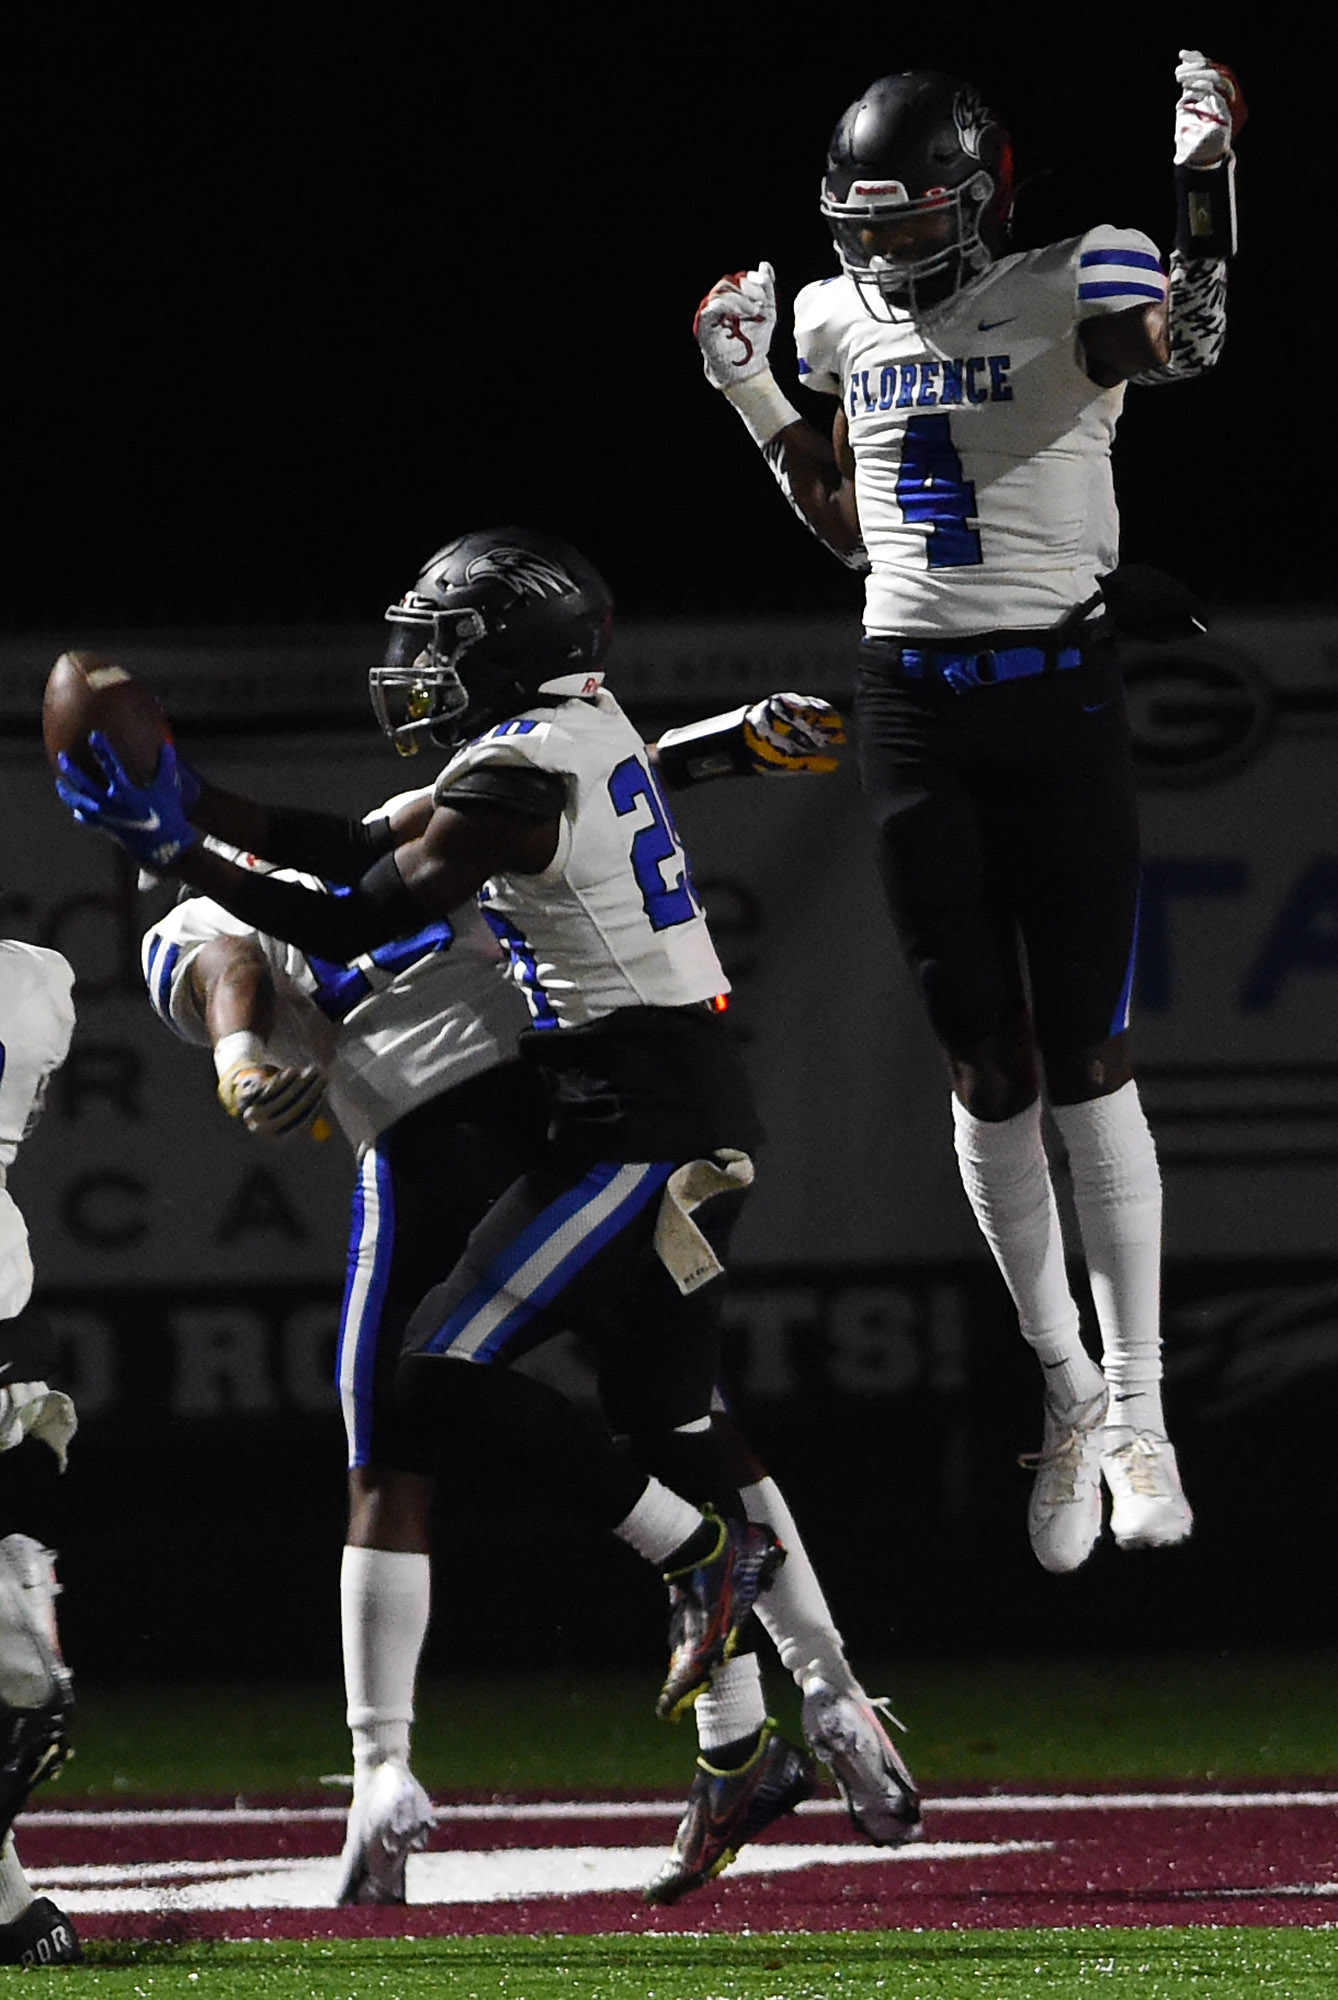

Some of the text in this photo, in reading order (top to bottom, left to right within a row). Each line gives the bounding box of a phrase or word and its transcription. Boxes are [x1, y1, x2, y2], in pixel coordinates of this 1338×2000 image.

[850, 354, 1014, 418] FLORENCE
[896, 412, 985, 569] 4
[606, 752, 702, 933] 2
